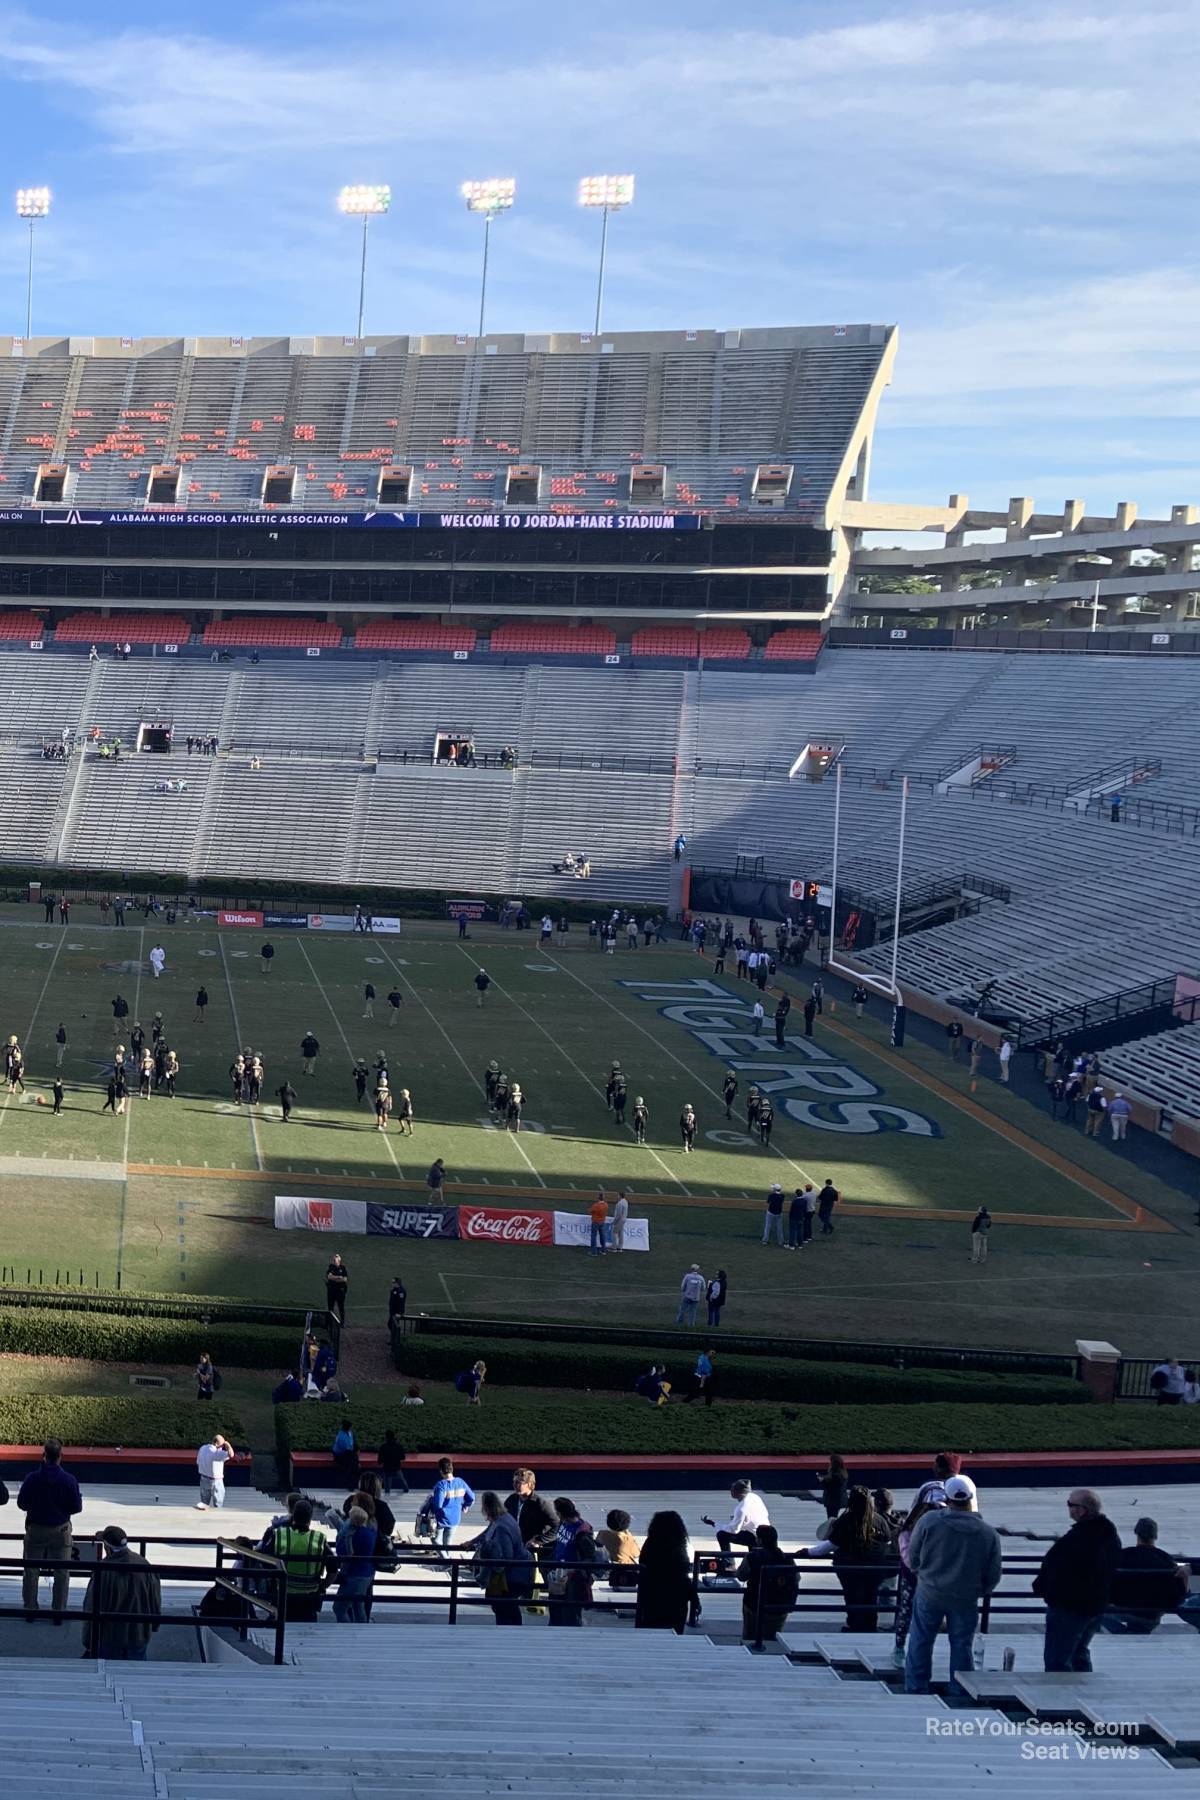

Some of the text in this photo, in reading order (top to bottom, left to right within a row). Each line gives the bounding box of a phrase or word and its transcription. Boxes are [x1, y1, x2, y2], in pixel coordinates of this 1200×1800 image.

[110, 514, 348, 524] ALABAMA HIGH SCHOOL ATHLETIC ASSOCIATION
[440, 515, 675, 529] WELCOME TO JORDAN-HARE STADIUM
[224, 914, 257, 923] Wilson
